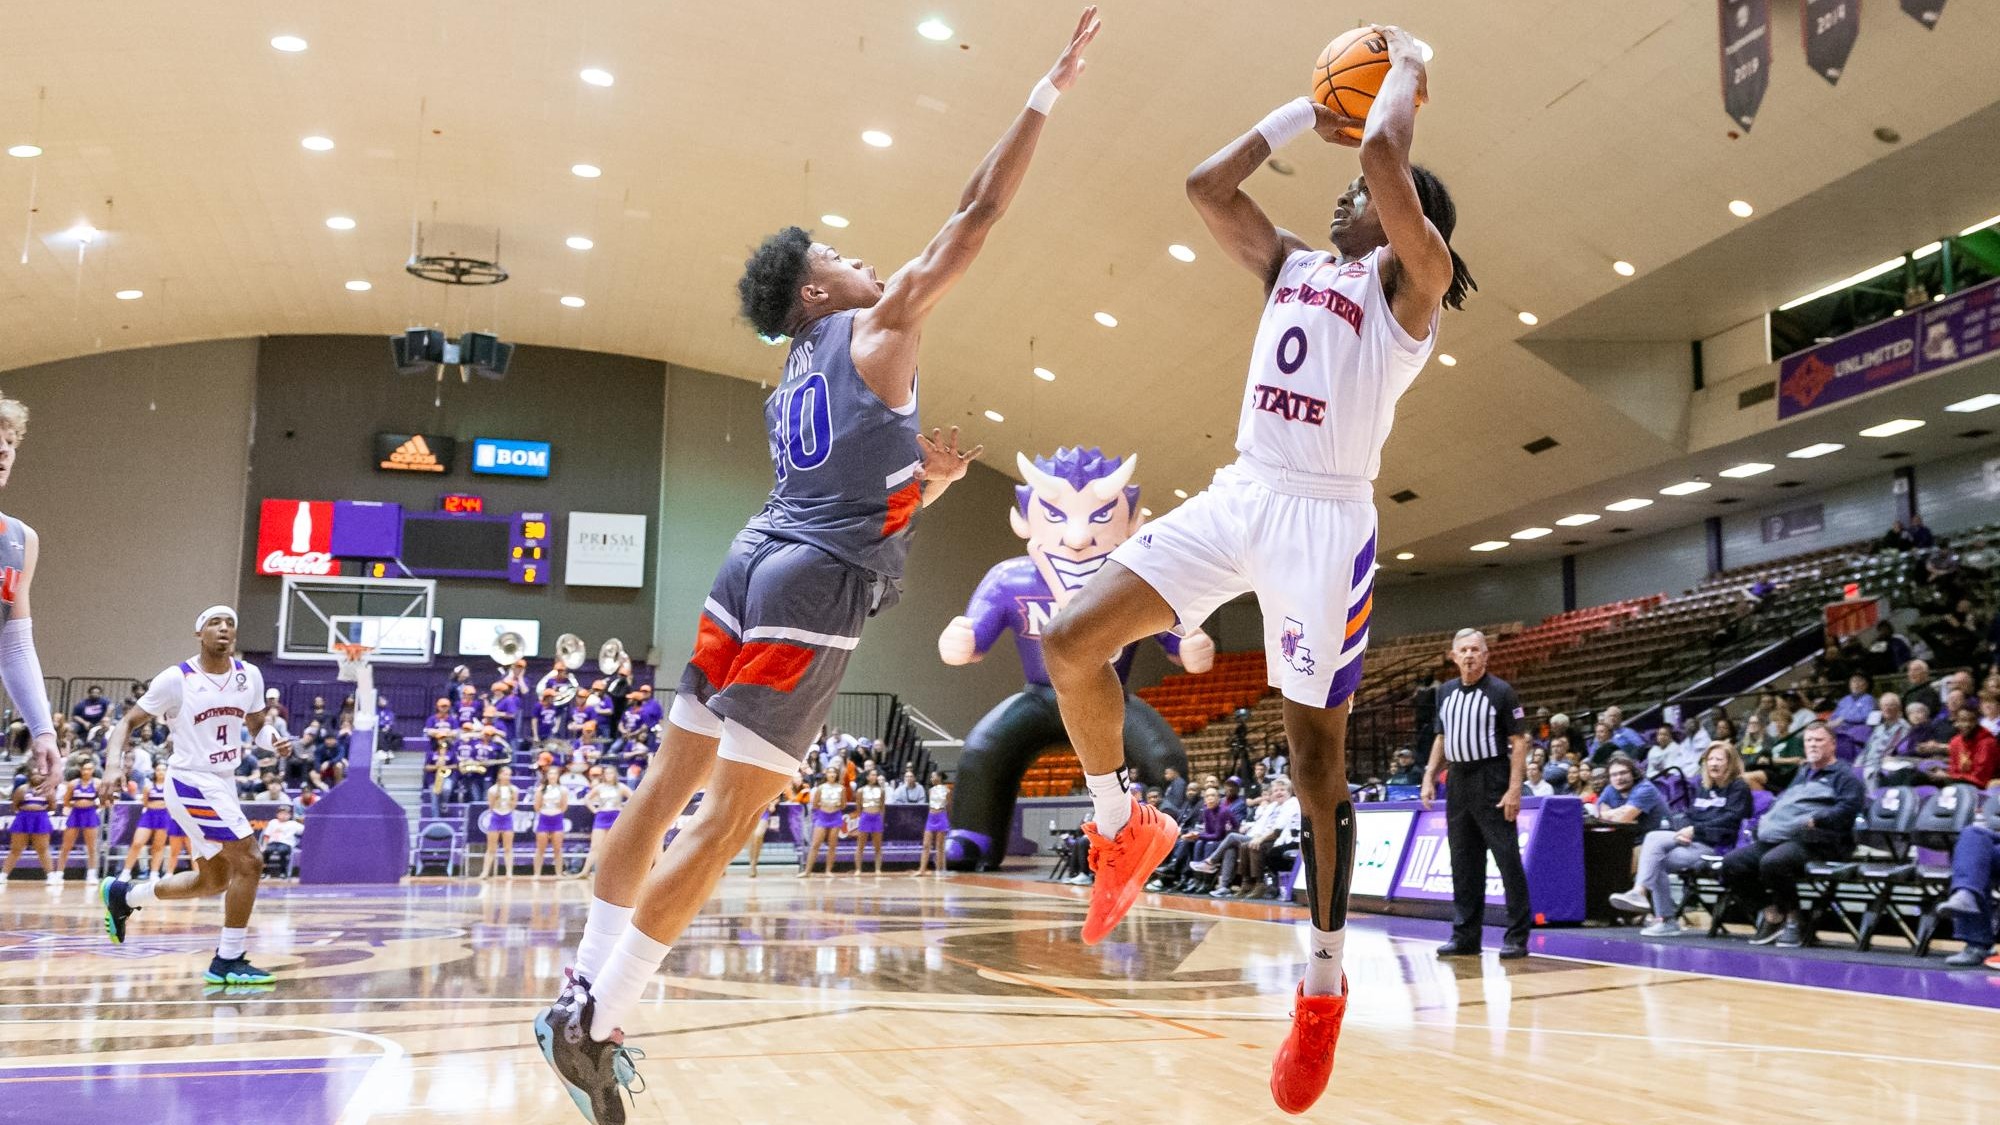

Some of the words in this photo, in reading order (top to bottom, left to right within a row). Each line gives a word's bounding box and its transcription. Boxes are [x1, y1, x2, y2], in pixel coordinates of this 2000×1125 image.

[1276, 326, 1308, 375] 0
[1835, 338, 1914, 377] UNLIMITED
[787, 341, 814, 382] KING
[496, 449, 546, 467] BOM
[579, 532, 635, 547] PRISM
[216, 725, 228, 746] 4
[1341, 818, 1349, 826] KT
